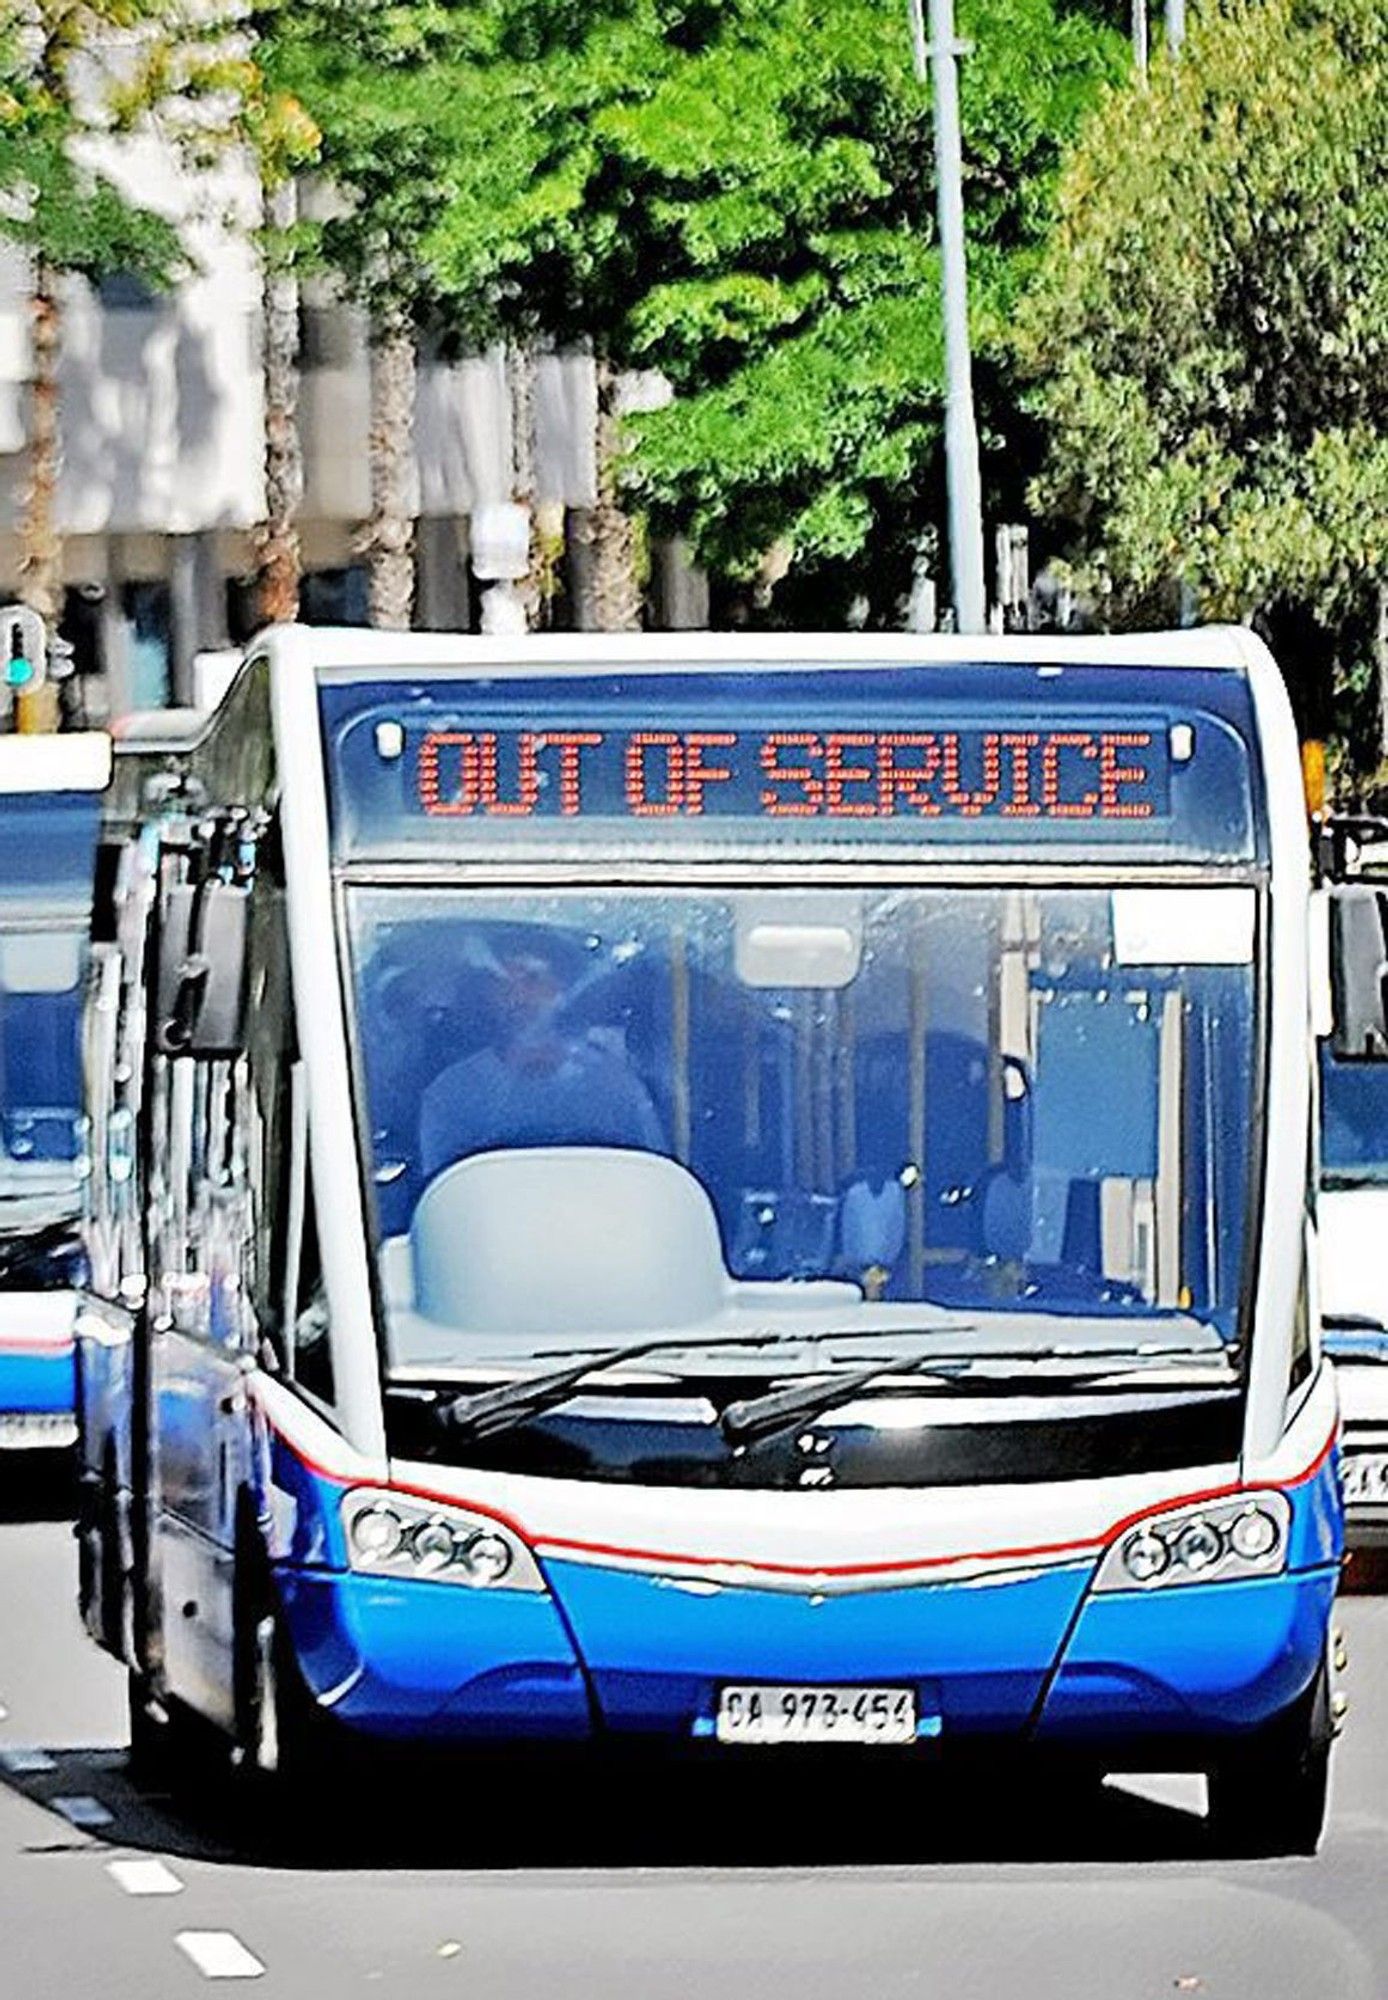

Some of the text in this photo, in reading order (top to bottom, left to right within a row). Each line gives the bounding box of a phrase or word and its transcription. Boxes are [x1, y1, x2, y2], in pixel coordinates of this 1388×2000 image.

[418, 733, 1152, 817] OUT OF SERVICE
[727, 1692, 763, 1729] CA
